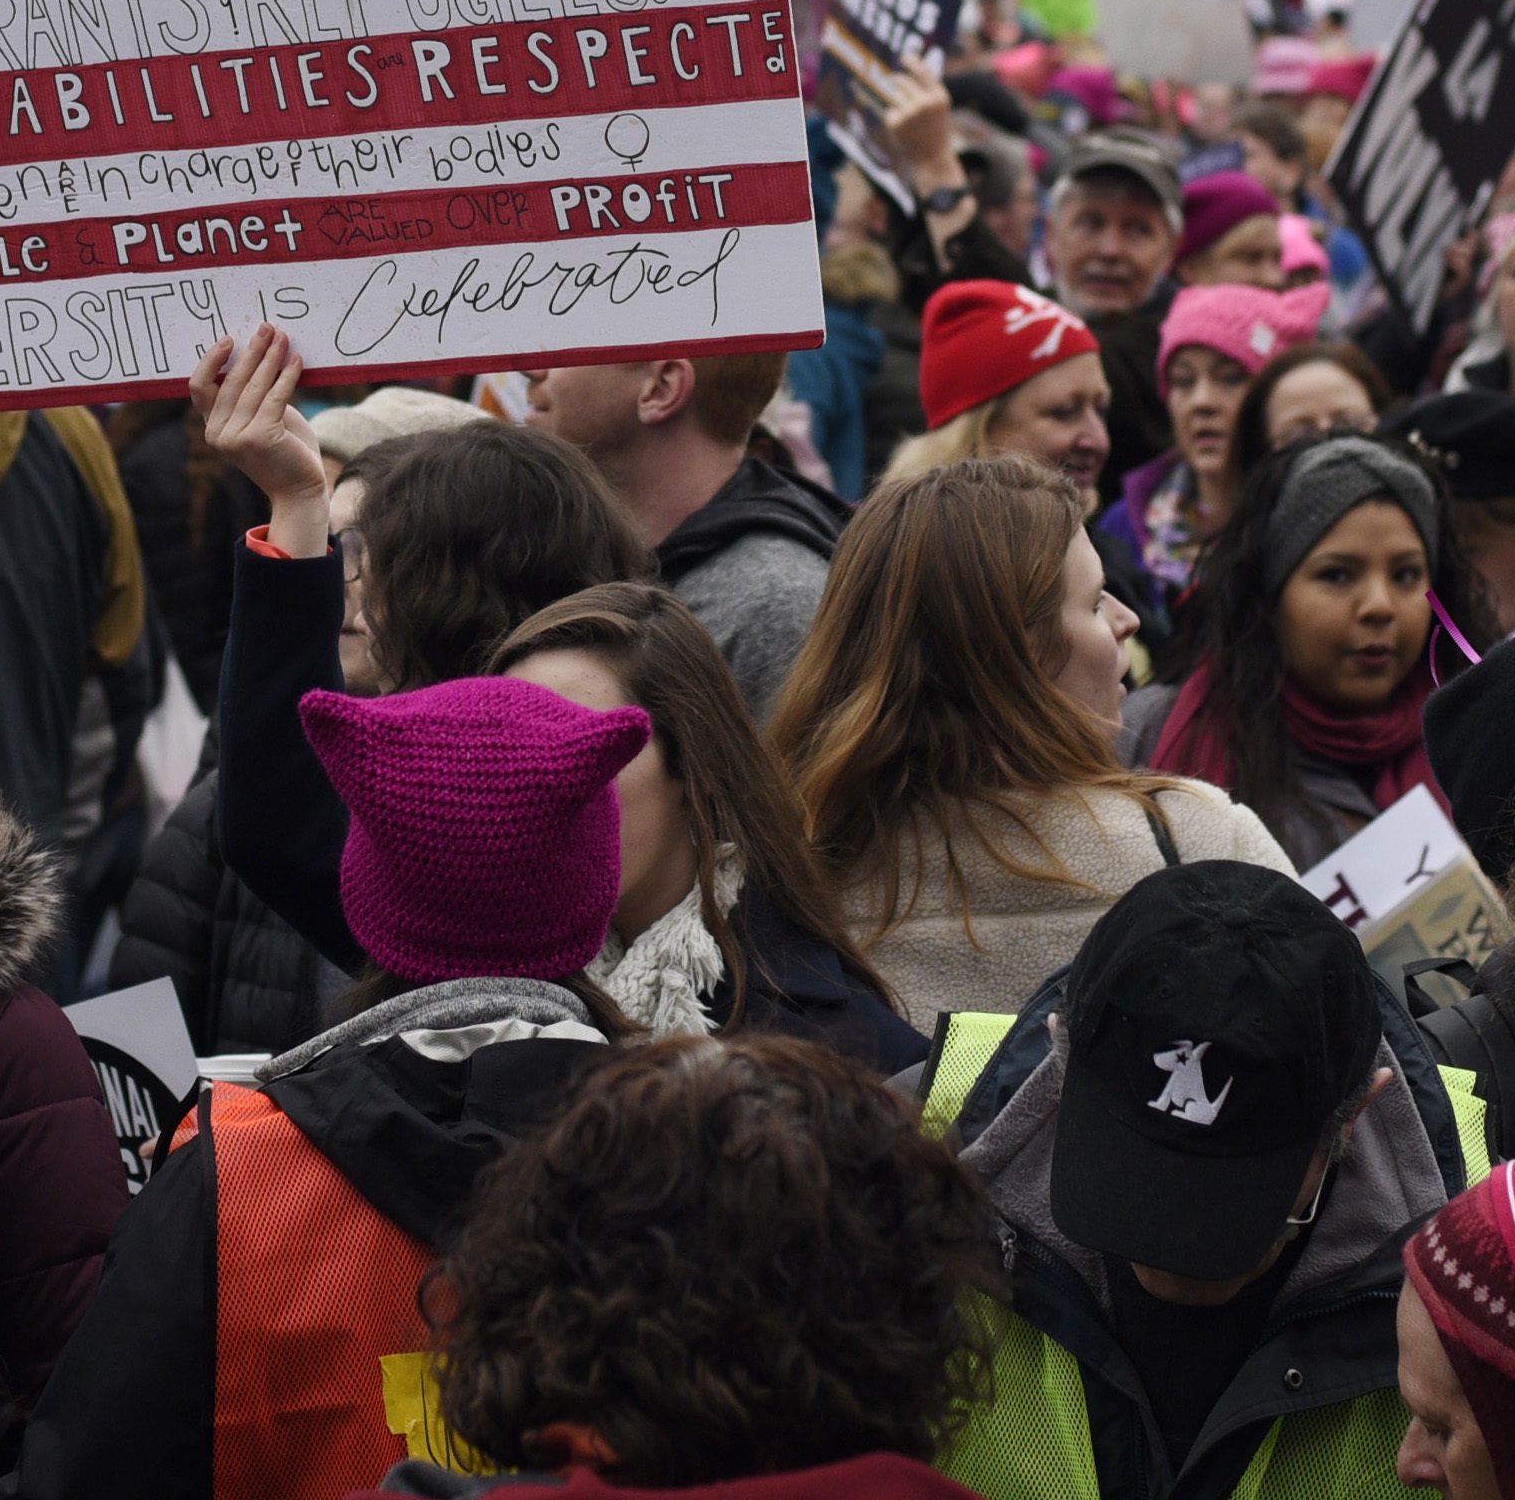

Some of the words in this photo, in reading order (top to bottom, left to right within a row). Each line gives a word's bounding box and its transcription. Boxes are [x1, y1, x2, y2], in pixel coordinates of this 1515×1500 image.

[321, 198, 386, 222] ARE
[317, 218, 435, 246] VALUED
[334, 227, 741, 357] Celebrated
